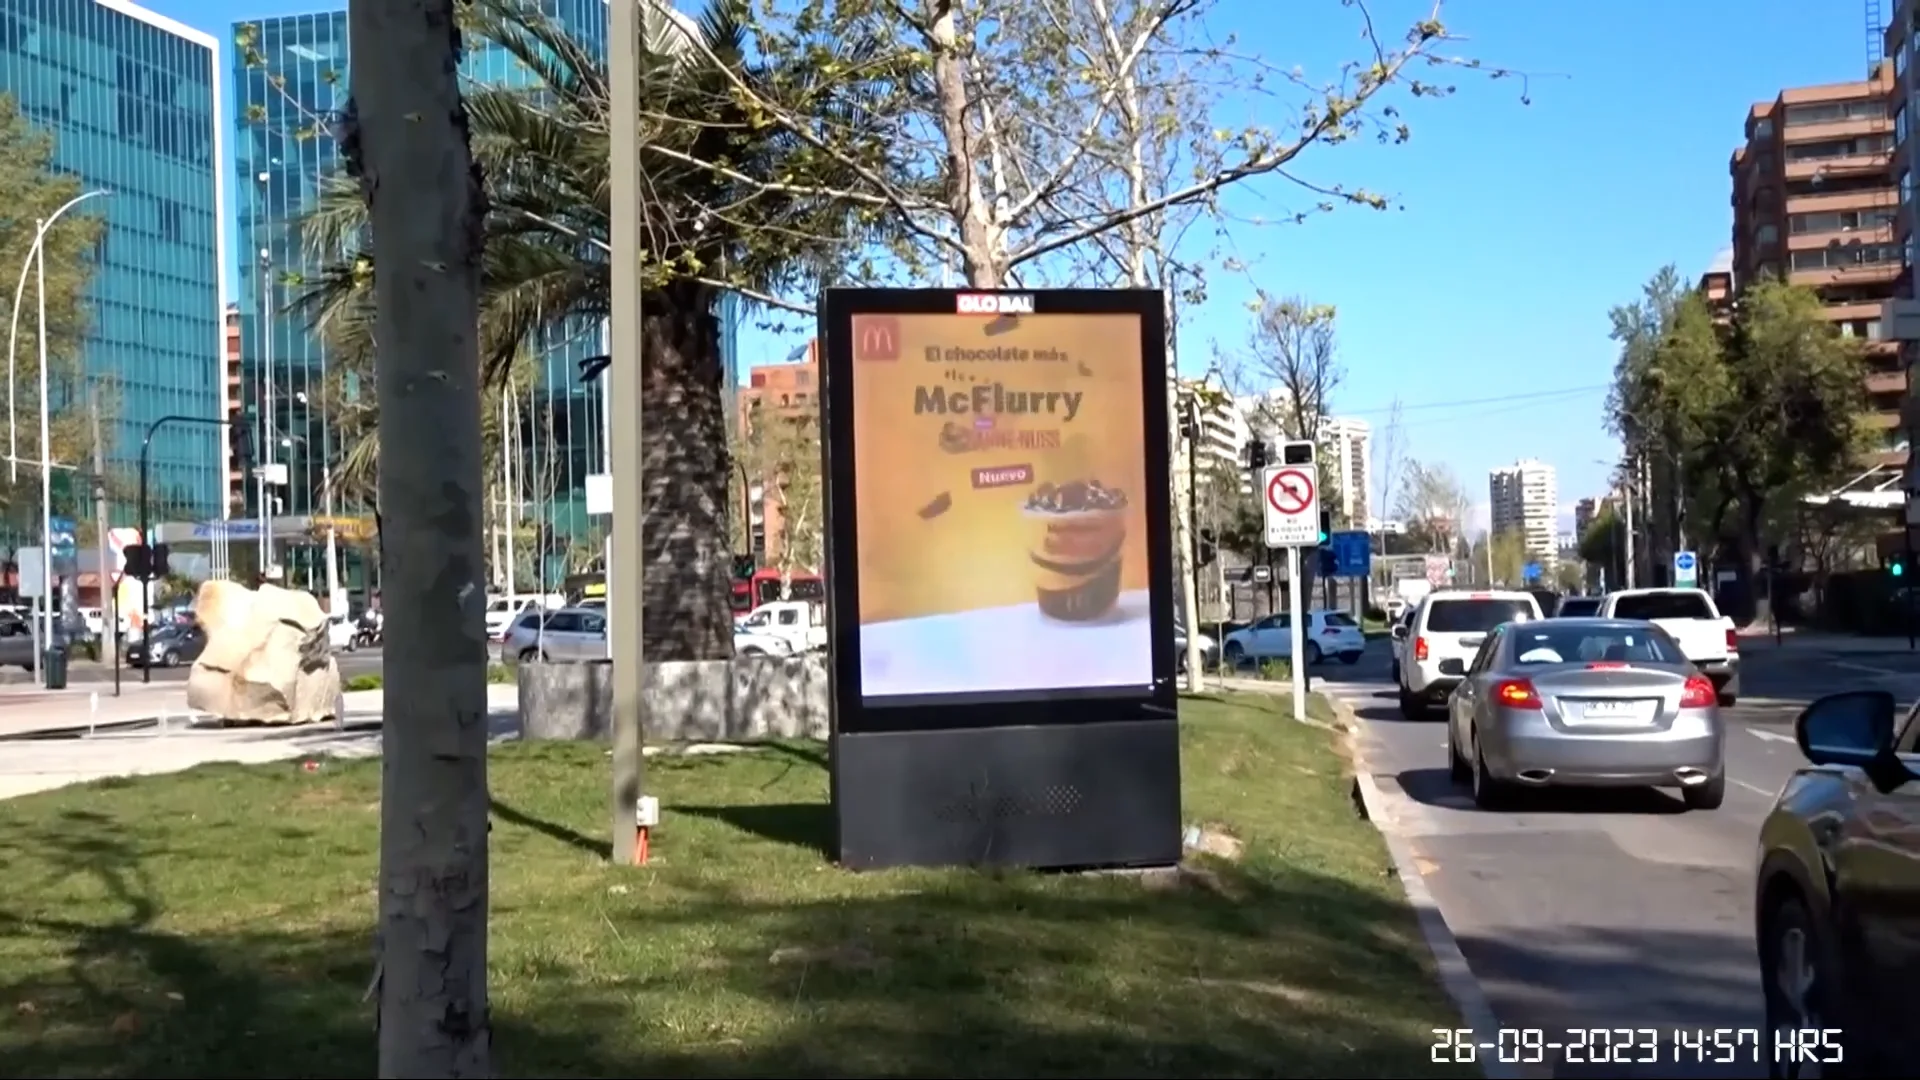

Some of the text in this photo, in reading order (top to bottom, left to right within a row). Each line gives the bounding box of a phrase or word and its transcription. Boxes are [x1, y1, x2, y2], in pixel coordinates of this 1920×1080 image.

[959, 296, 1033, 312] GLOBAL
[924, 345, 1068, 362] El chocolate más
[914, 382, 1083, 423] McFlurry
[978, 469, 1027, 485] Nuevo
